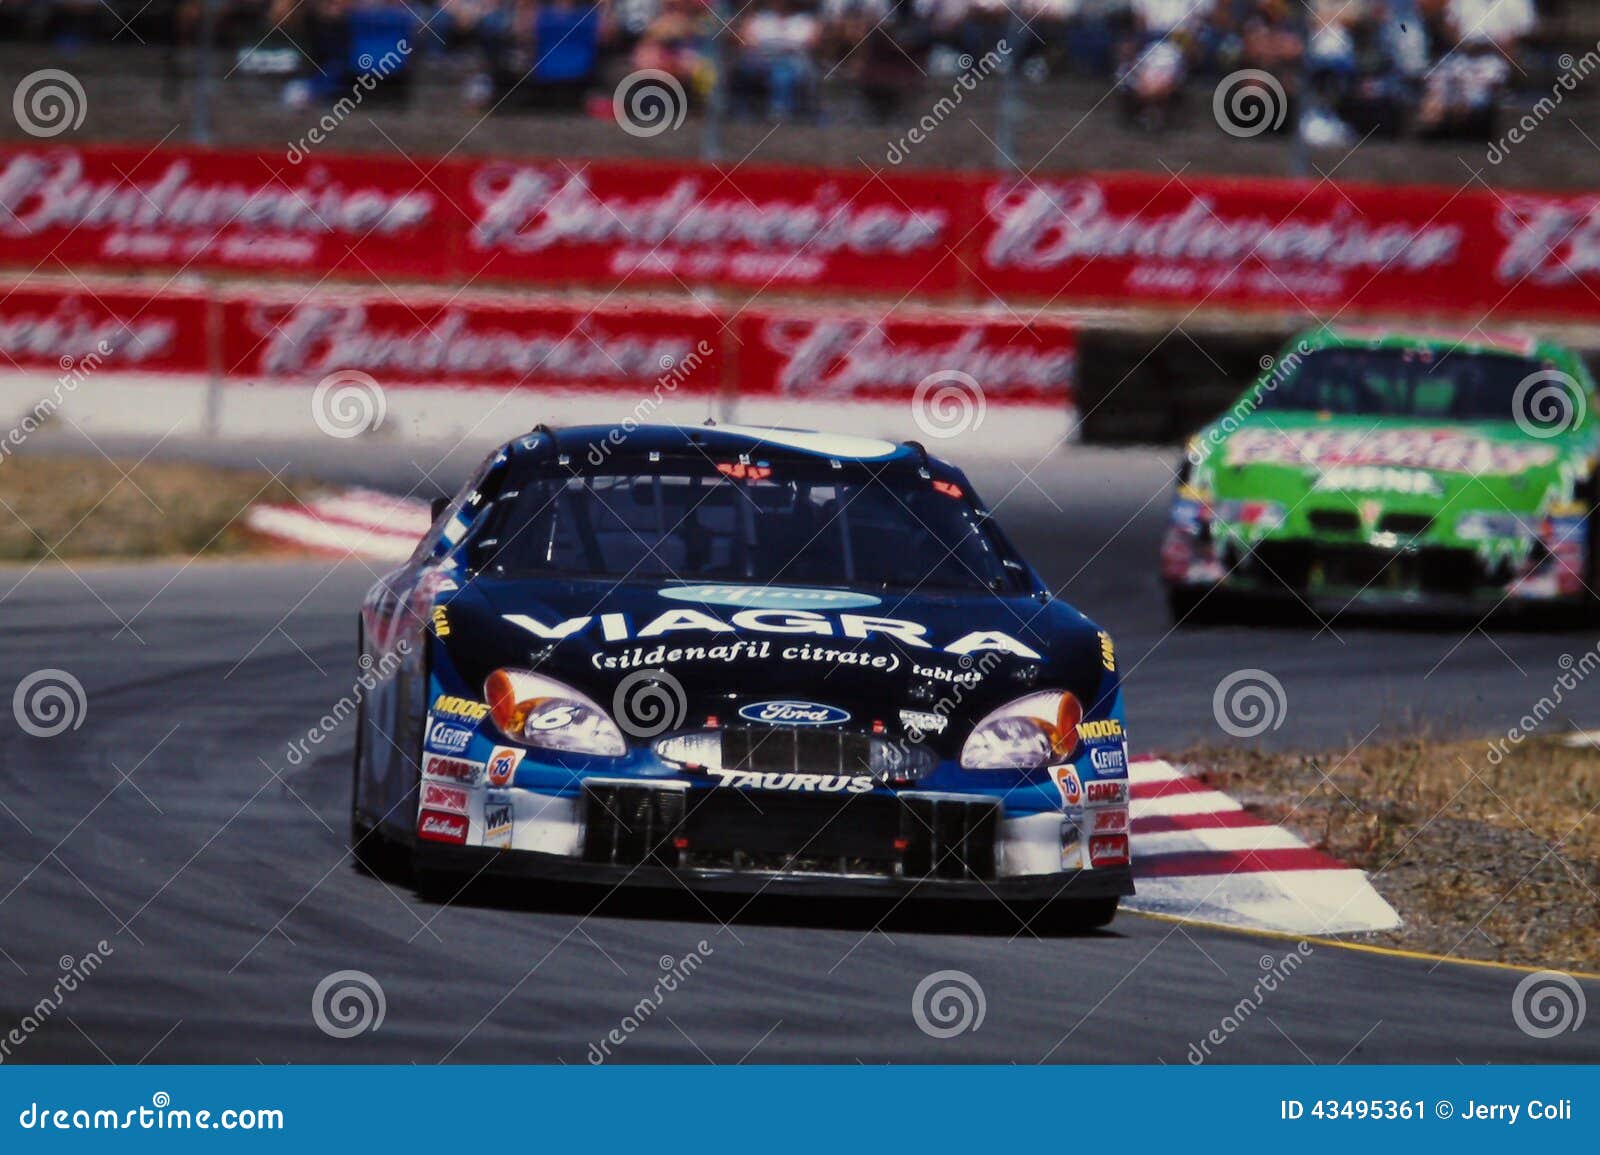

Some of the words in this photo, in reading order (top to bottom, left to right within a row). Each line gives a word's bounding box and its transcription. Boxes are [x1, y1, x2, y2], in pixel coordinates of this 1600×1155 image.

[0, 150, 434, 238] Budweiser
[470, 160, 946, 257] Budweiser
[984, 178, 1464, 272] Budweiser
[0, 290, 177, 363] eiser
[249, 300, 694, 377] Budweiser
[764, 316, 1077, 398] Budwe
[501, 608, 1042, 660] VIAGRA
[592, 641, 771, 669] (sildenafil
[782, 642, 900, 672] citrate)
[912, 664, 981, 682] tablets
[433, 695, 491, 719] MOOG
[530, 706, 575, 730] 6
[759, 702, 829, 721] Ford
[1076, 719, 1122, 740] MOOG
[427, 757, 470, 779] COMP
[493, 757, 511, 776] 76
[707, 767, 875, 794] TAURUS
[1062, 774, 1077, 793] 76
[1088, 783, 1119, 803] COMP
